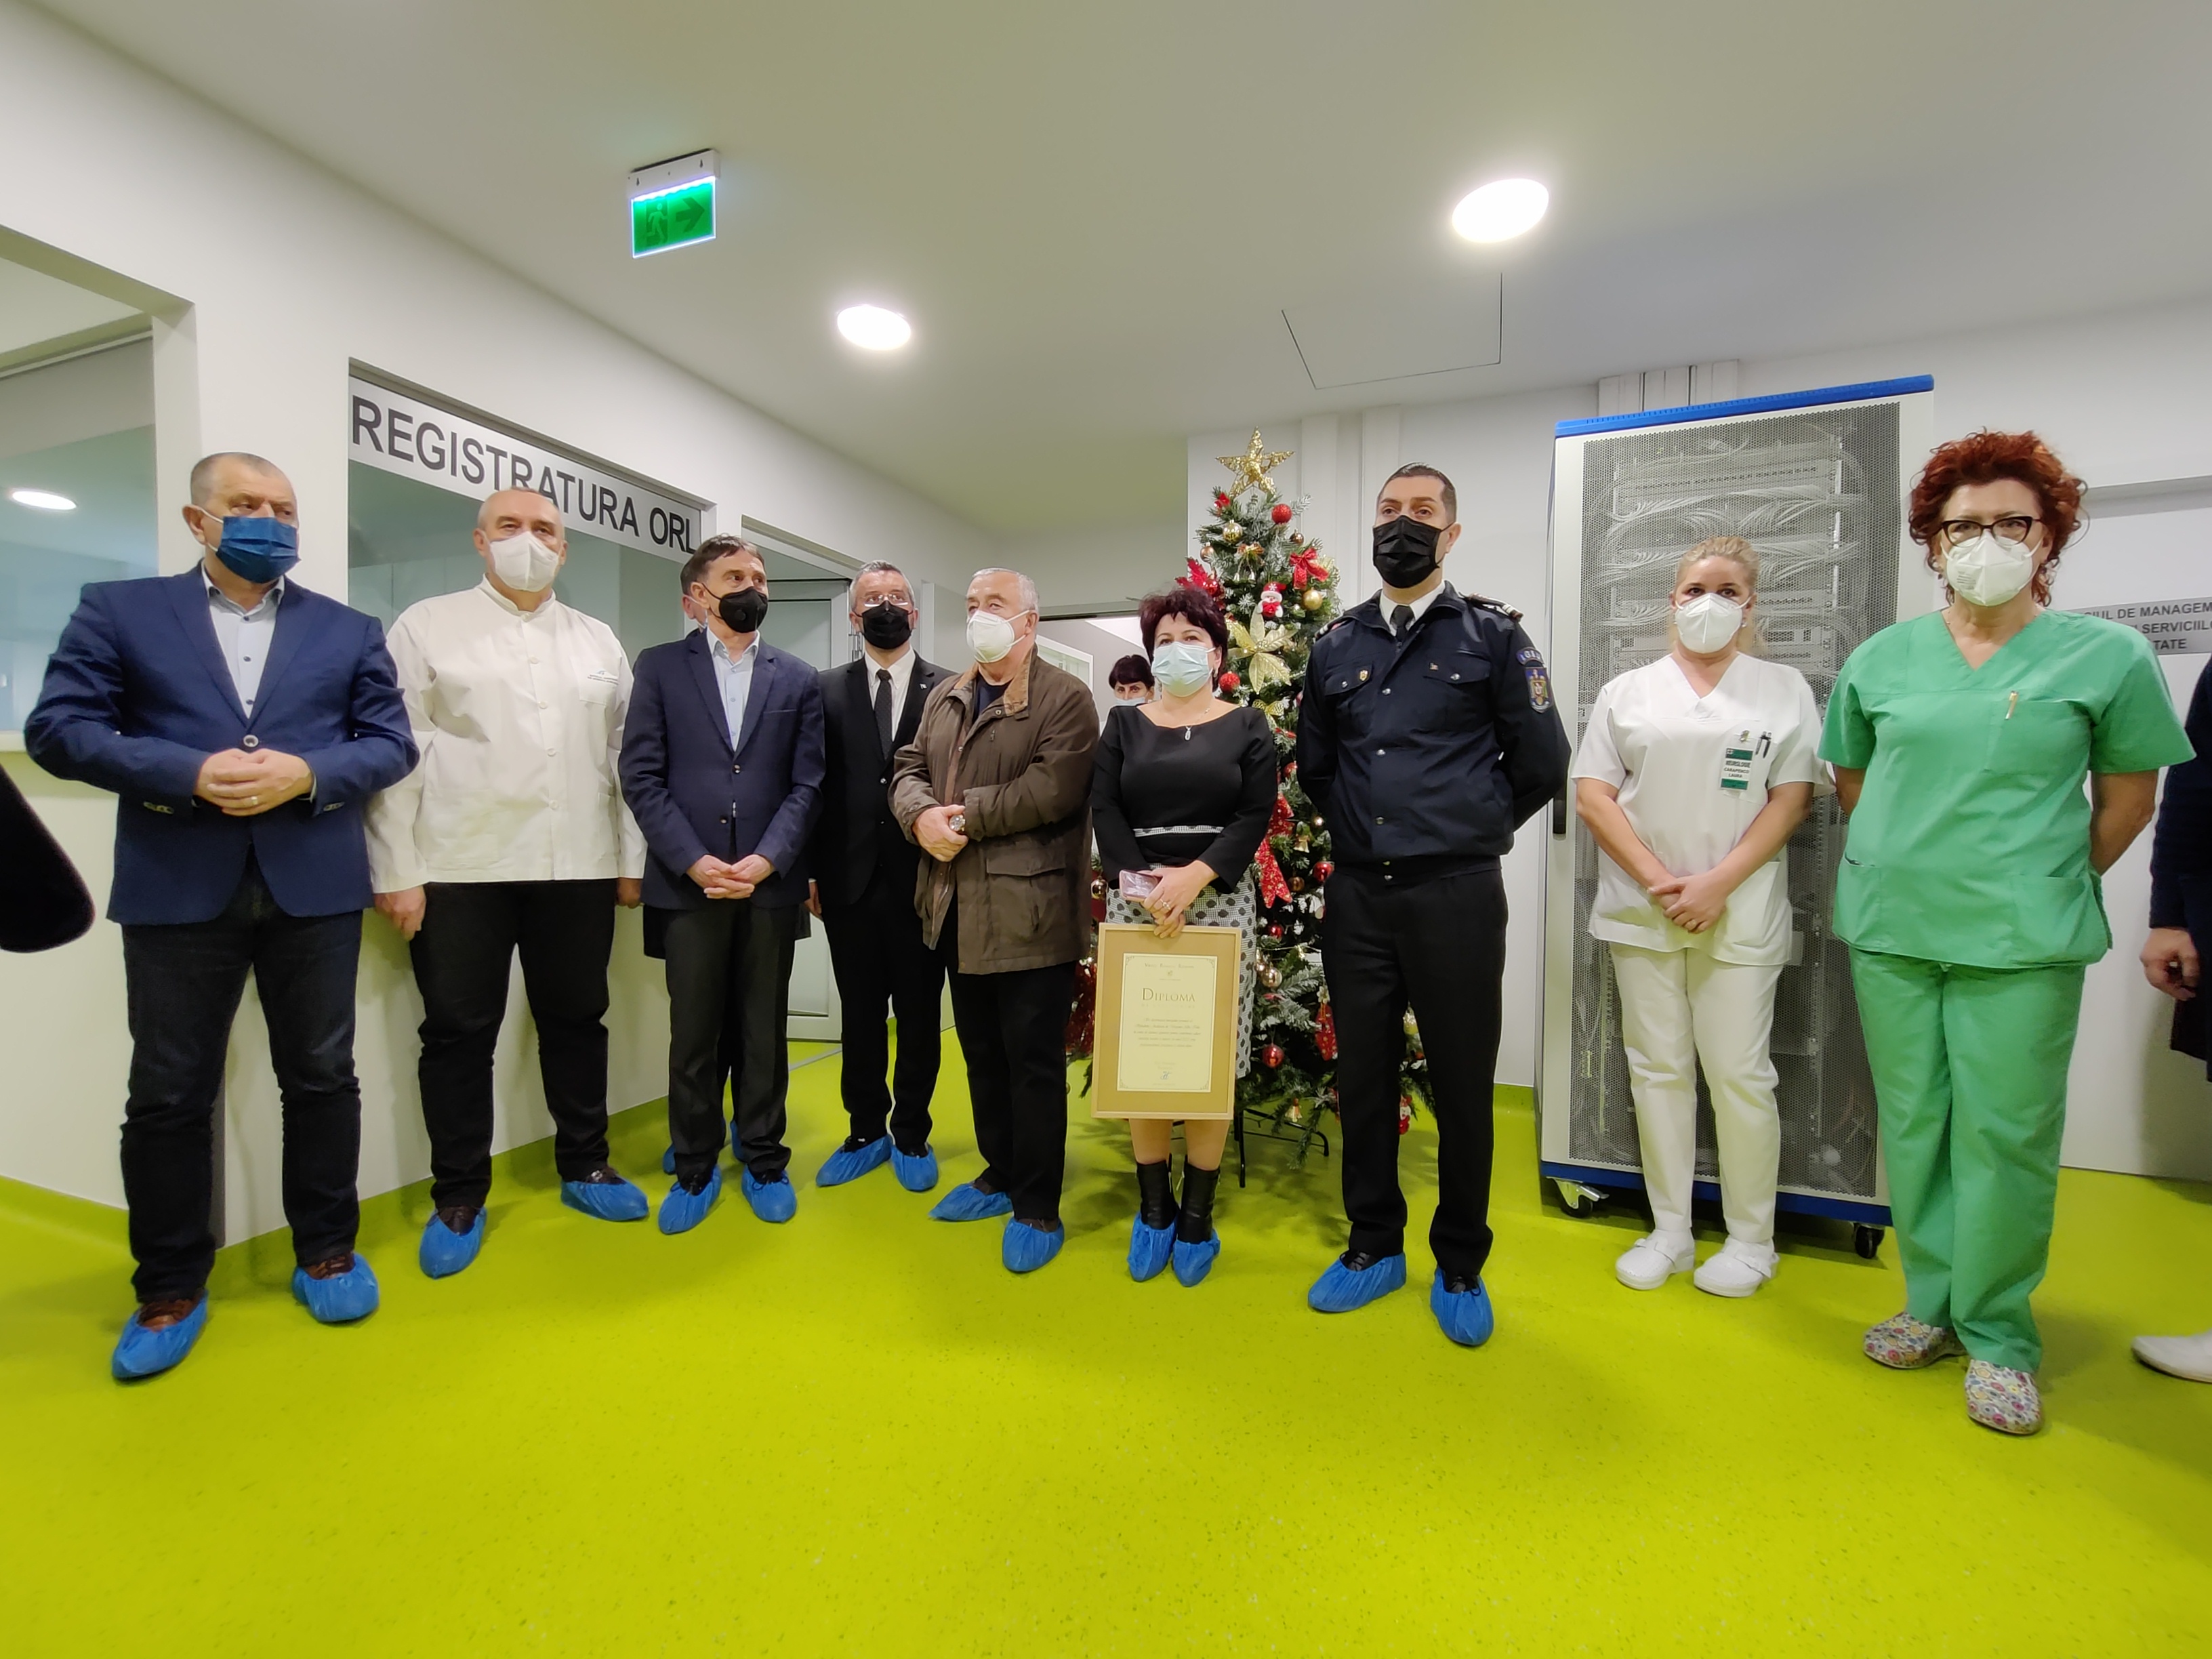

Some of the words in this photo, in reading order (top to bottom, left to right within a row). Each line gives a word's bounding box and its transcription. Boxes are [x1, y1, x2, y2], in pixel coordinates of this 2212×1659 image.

[352, 394, 640, 537] REGISTRATURA
[649, 507, 697, 555] ORL
[2117, 608, 2135, 619] DE
[2142, 619, 2212, 634] SERVICIIL
